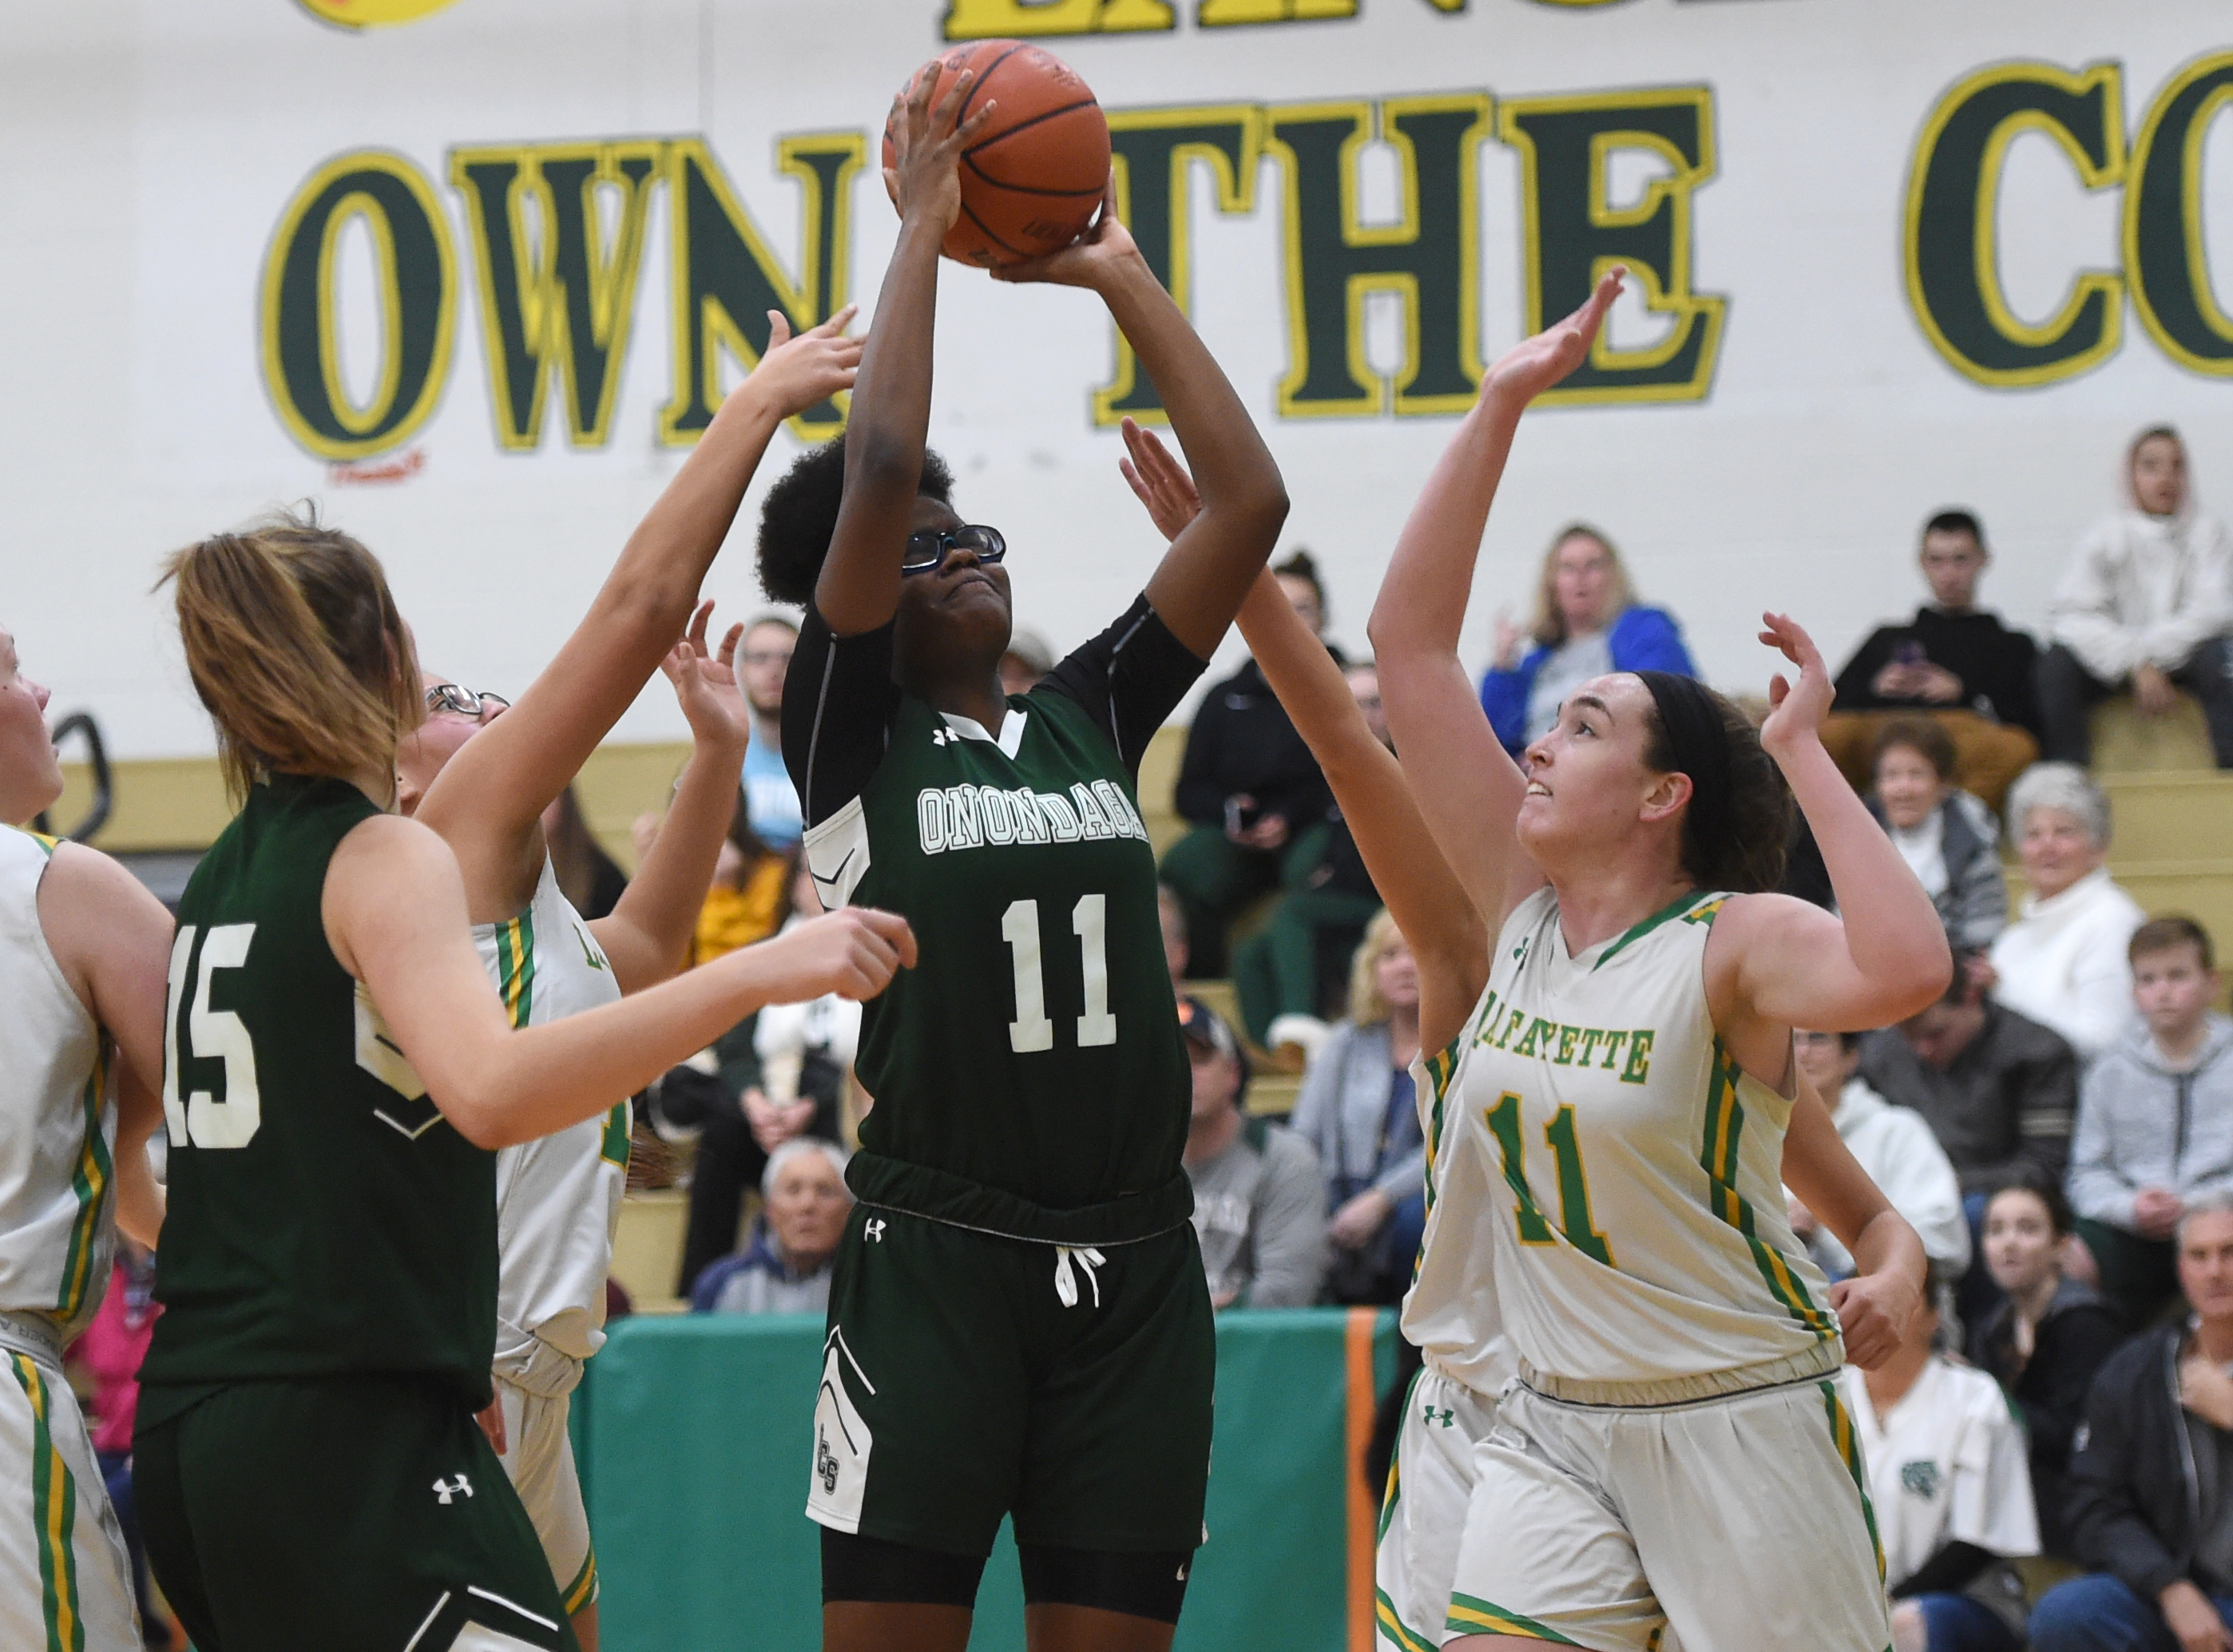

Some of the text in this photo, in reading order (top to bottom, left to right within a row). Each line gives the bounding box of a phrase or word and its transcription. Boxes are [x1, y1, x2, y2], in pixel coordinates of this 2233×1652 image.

[261, 51, 2233, 460] OWN THE CO
[162, 923, 260, 1149] 15
[1001, 893, 1116, 1053] 11
[1484, 1090, 1617, 1269] 11
